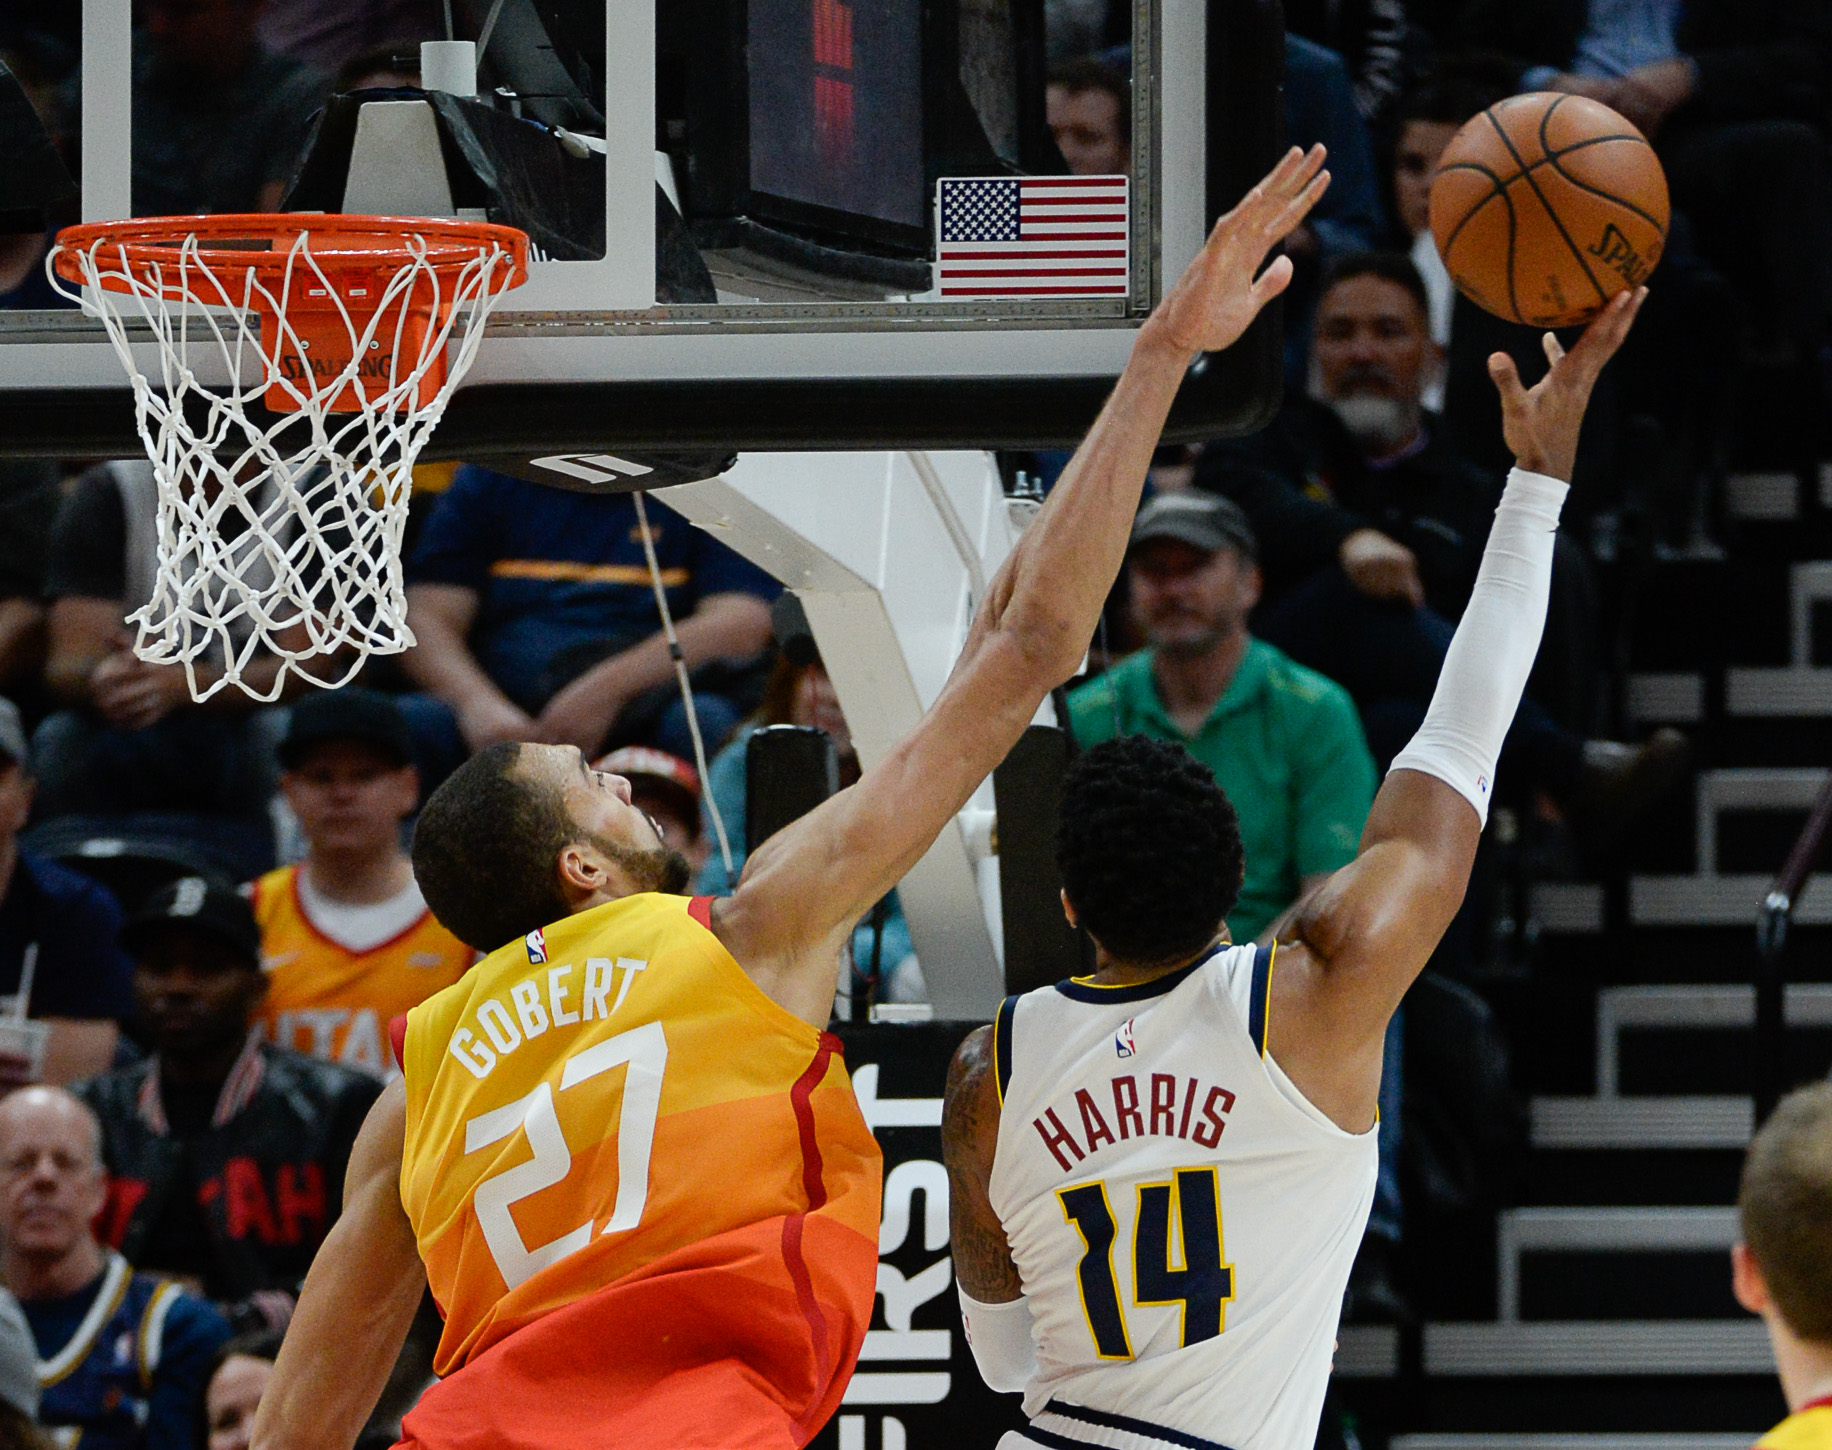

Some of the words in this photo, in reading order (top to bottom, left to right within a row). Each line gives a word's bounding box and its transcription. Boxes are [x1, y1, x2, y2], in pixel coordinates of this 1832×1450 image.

[450, 957, 648, 1079] GOBERT
[464, 1020, 668, 1292] 27
[1032, 1073, 1237, 1172] HARRIS
[1054, 1165, 1236, 1360] 14
